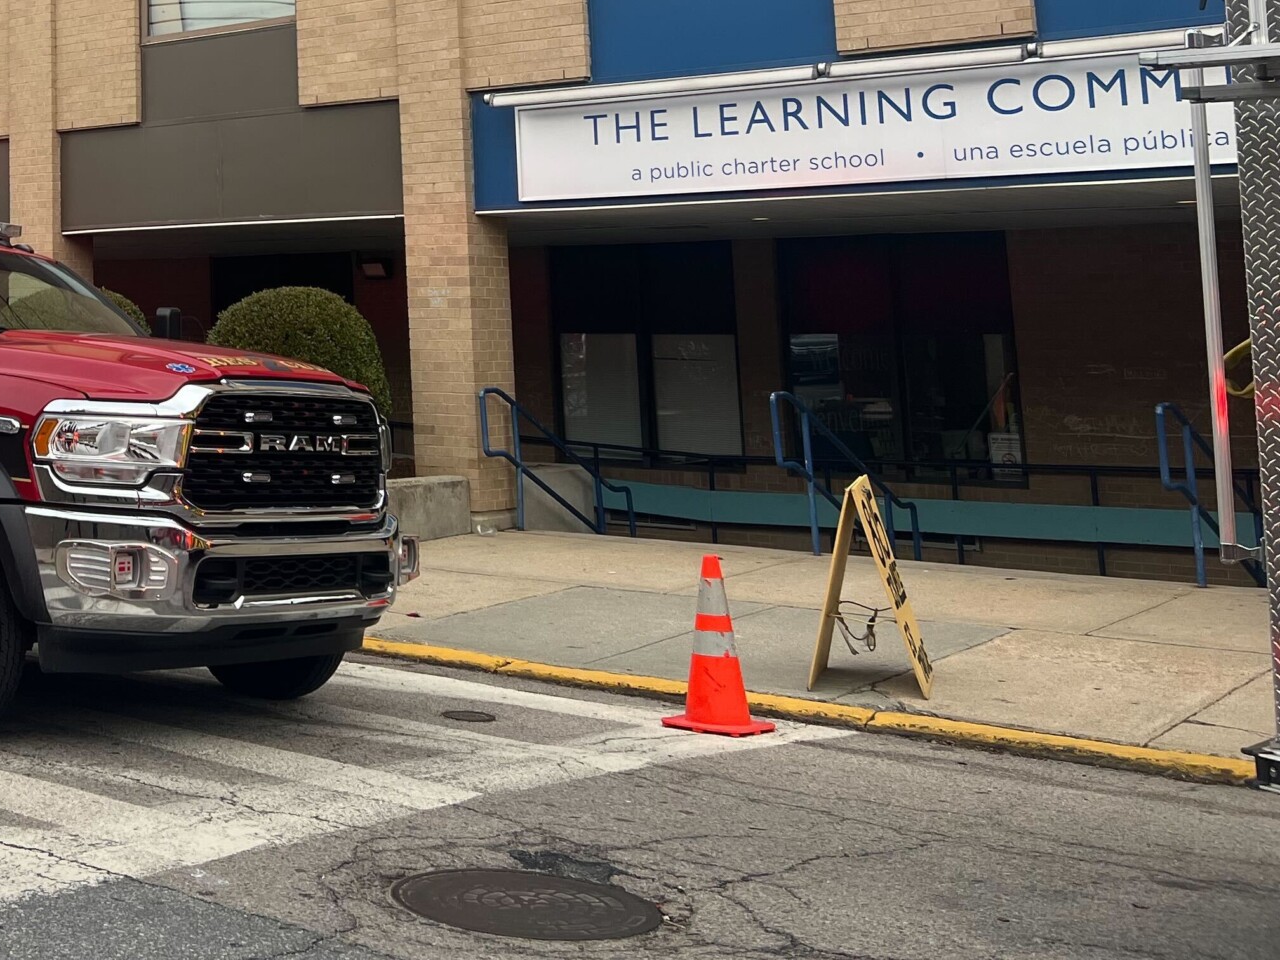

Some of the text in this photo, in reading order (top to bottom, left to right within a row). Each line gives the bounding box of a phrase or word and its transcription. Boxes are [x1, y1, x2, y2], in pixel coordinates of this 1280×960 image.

[583, 109, 669, 145] THE
[692, 83, 957, 138] LEARNING
[631, 128, 1230, 183] a public charter school una escuela públia
[260, 434, 341, 452] RAM
